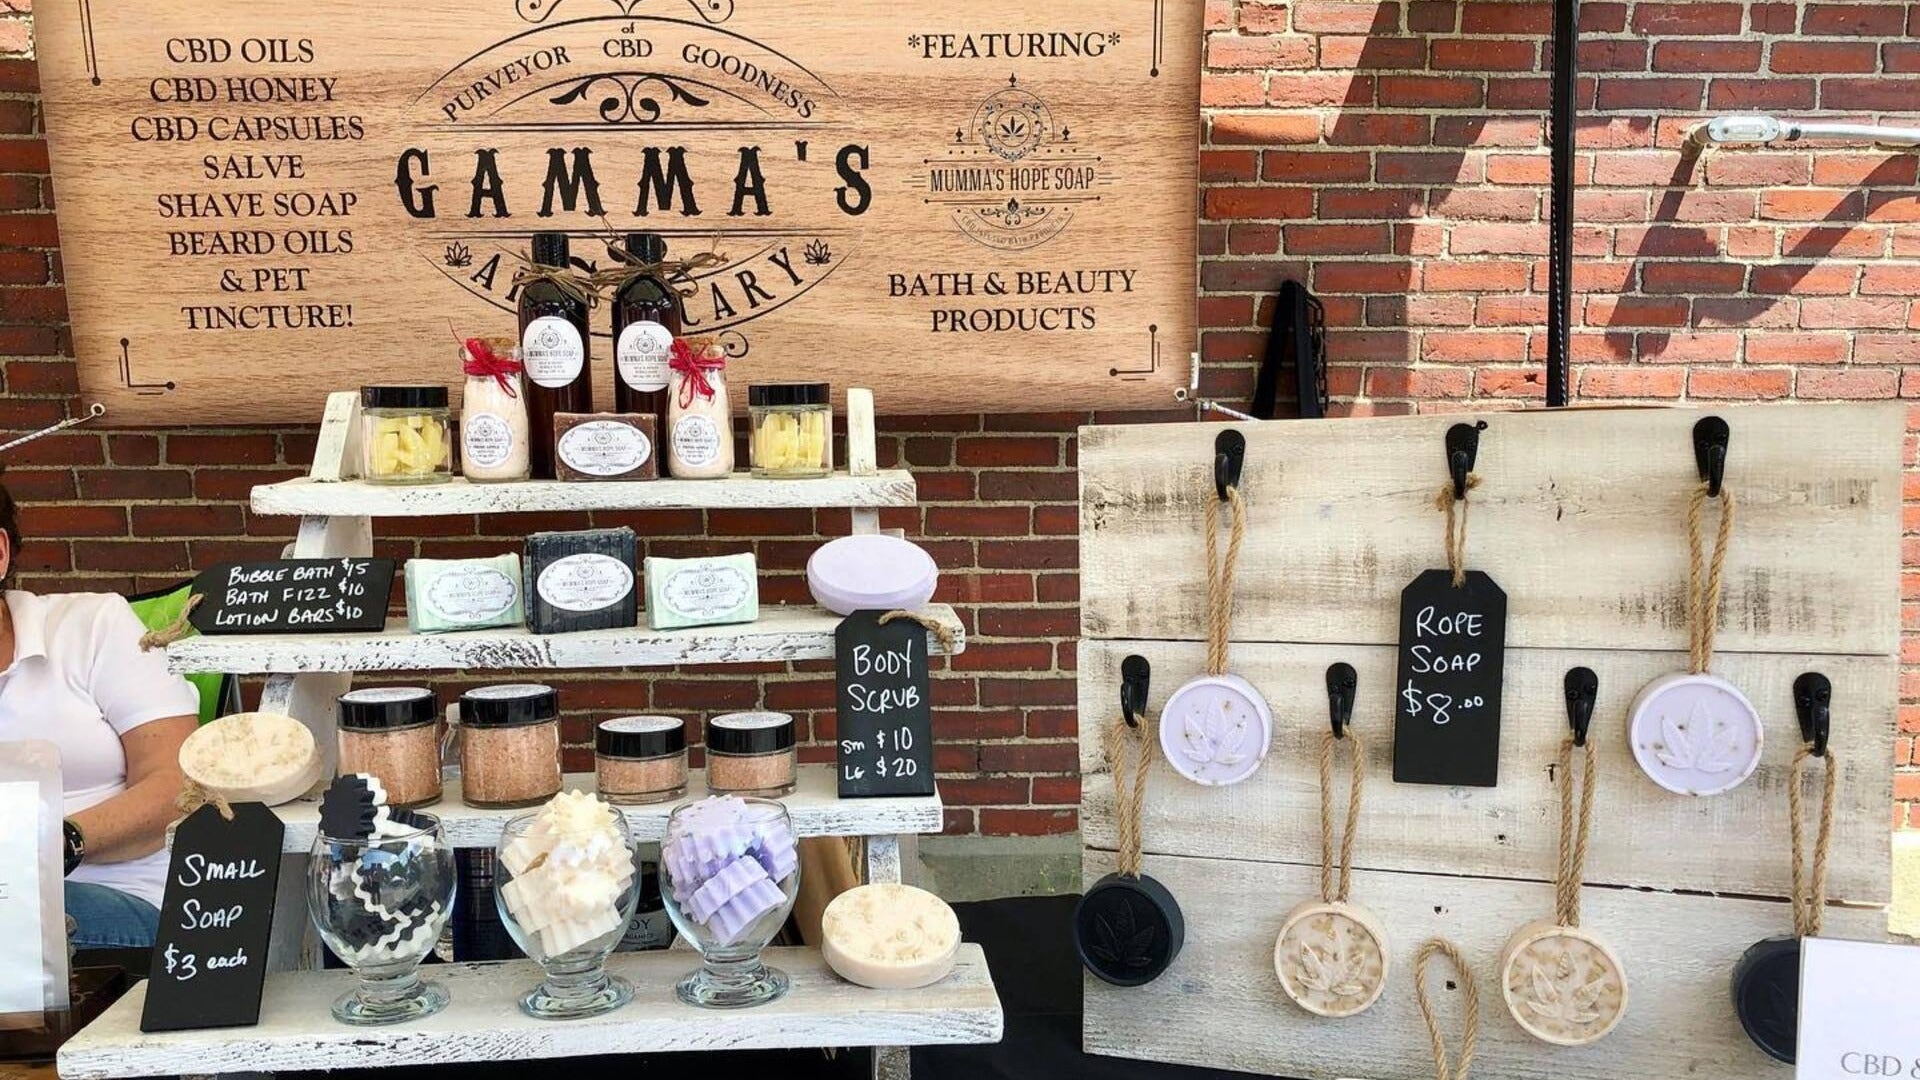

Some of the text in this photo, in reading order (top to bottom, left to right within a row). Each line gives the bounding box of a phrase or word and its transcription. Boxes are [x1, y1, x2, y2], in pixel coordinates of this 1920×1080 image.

[621, 21, 636, 35] of
[166, 37, 315, 63] CBD OILS
[150, 77, 338, 103] CBD HONEY
[441, 38, 817, 123] PURVEYOR CBD GOODNESS
[131, 115, 365, 142] CBD CAPSULES
[203, 154, 306, 180] SALVE
[394, 141, 873, 220] GAMMA'S
[930, 166, 1095, 192] MUMMA'S HOPE SOAP
[157, 192, 358, 218] SHAVE SOAP
[167, 230, 354, 256] BEARD OILS
[219, 267, 310, 293] & PET
[888, 269, 1137, 298] BATH & BEAUTY
[181, 304, 354, 330] TINCTURE!
[930, 307, 1096, 332] PRODUCTS
[228, 557, 370, 586] BUBBLE BATH $15
[226, 577, 365, 606] BATH FIZZ $10
[215, 598, 363, 626] LOTION BARS $10
[1416, 606, 1483, 637] ROPE
[853, 639, 912, 678] BODY
[1411, 645, 1481, 674] SOAP
[847, 683, 920, 714] SCRUB
[1402, 678, 1484, 725] $8.00
[178, 853, 266, 887] SMALL
[181, 899, 243, 931] SOAP
[164, 943, 248, 981] $3 each
[1841, 1051, 1902, 1077] CBD
